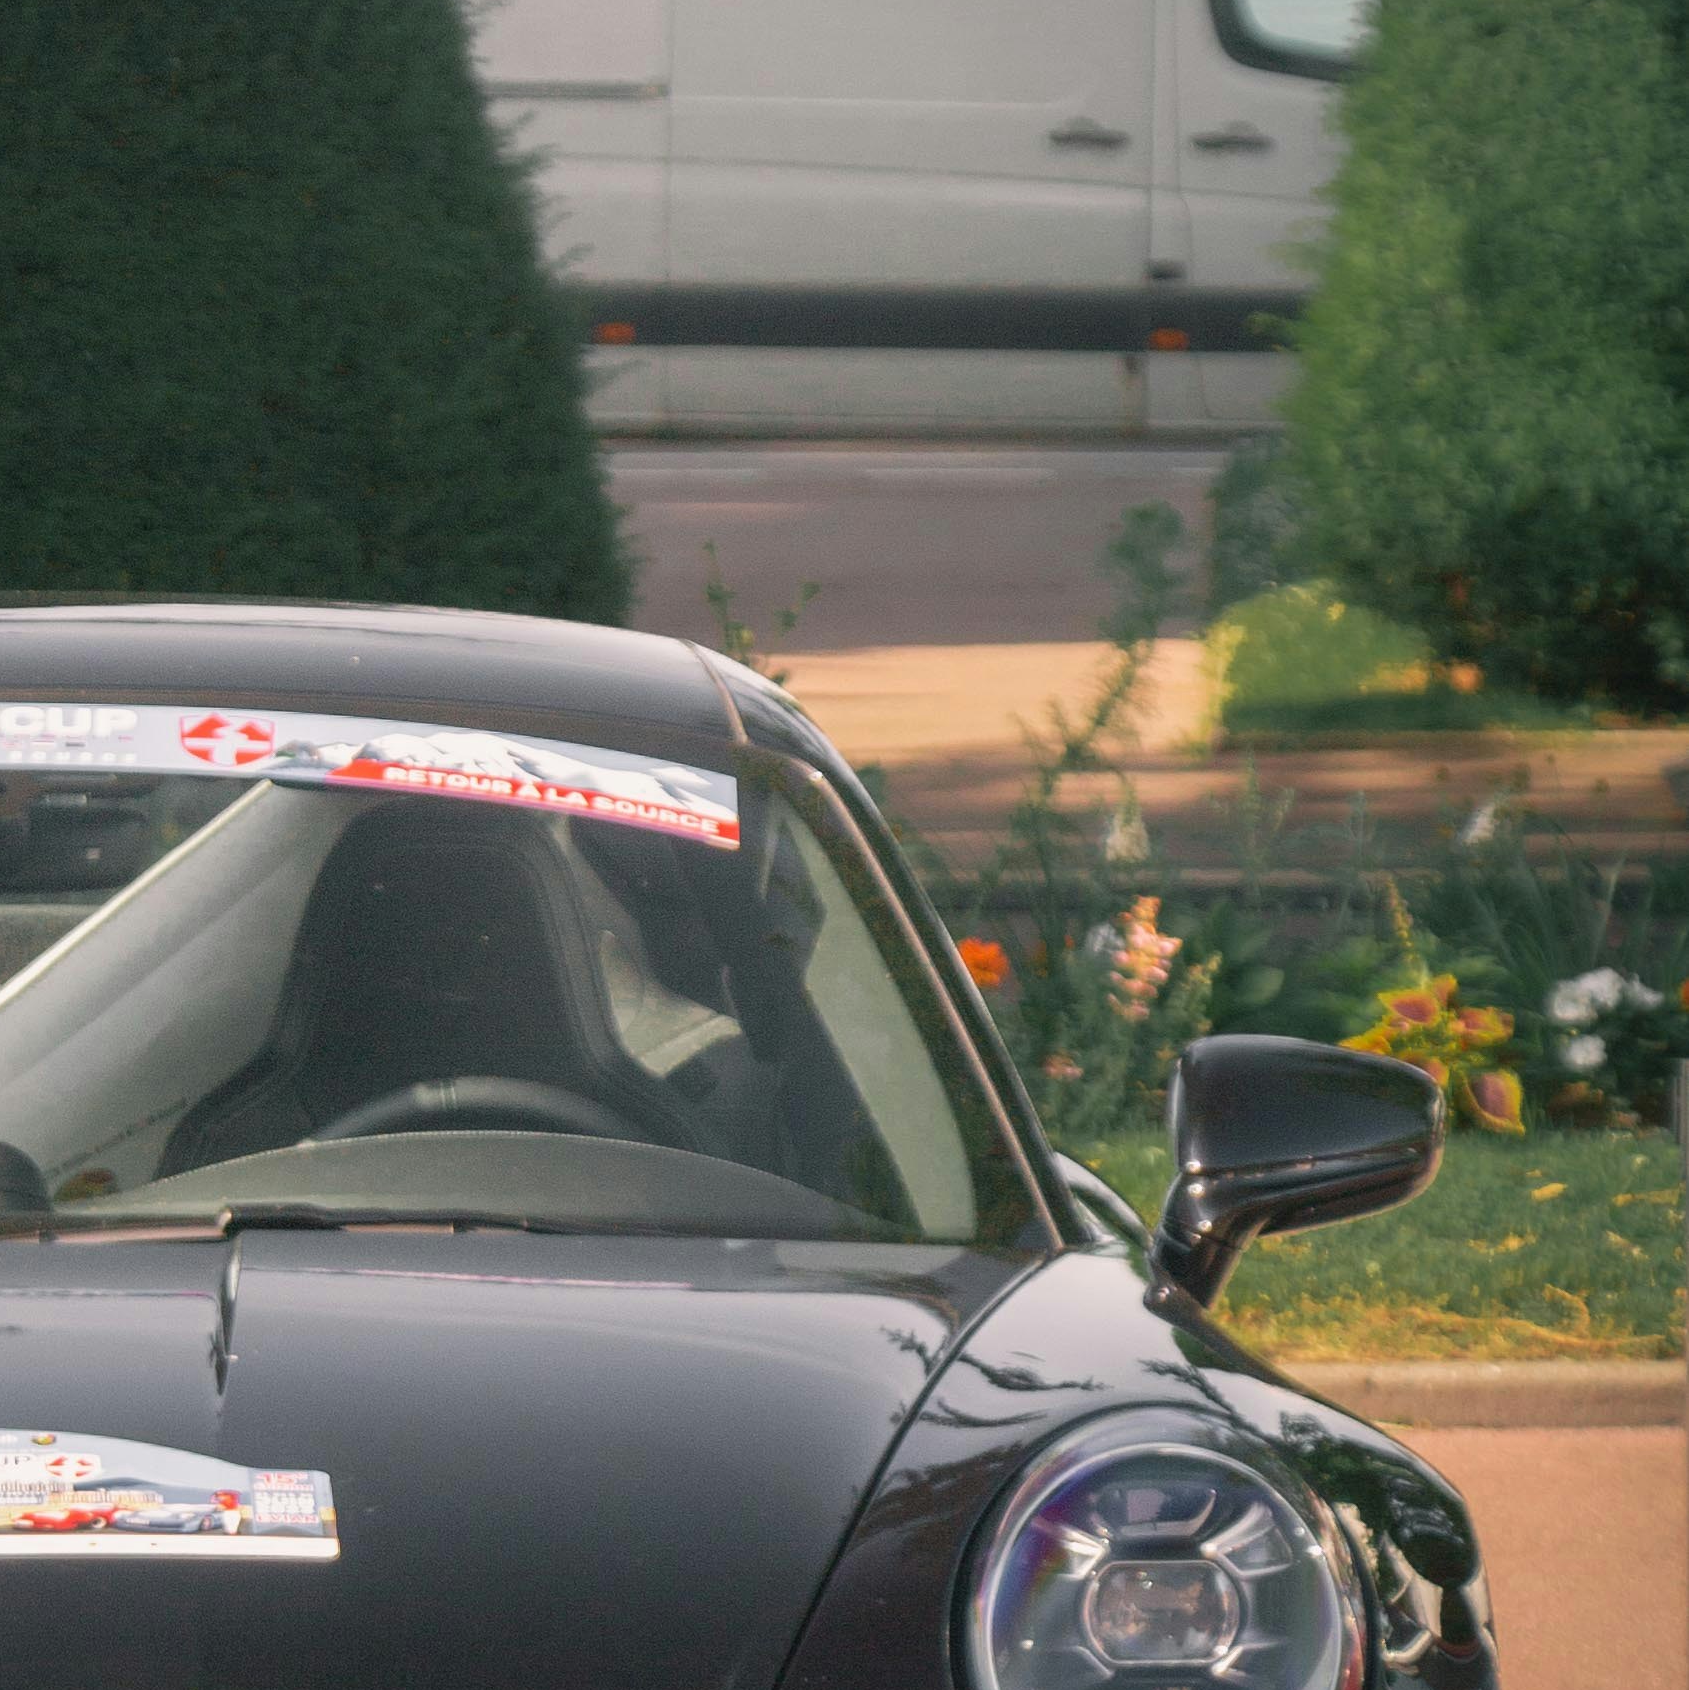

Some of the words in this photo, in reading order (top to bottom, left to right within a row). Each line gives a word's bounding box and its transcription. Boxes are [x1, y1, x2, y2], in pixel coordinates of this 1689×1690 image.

[383, 766, 512, 795] RETOUR
[547, 786, 589, 807] LA
[593, 794, 721, 834] SOURCE
